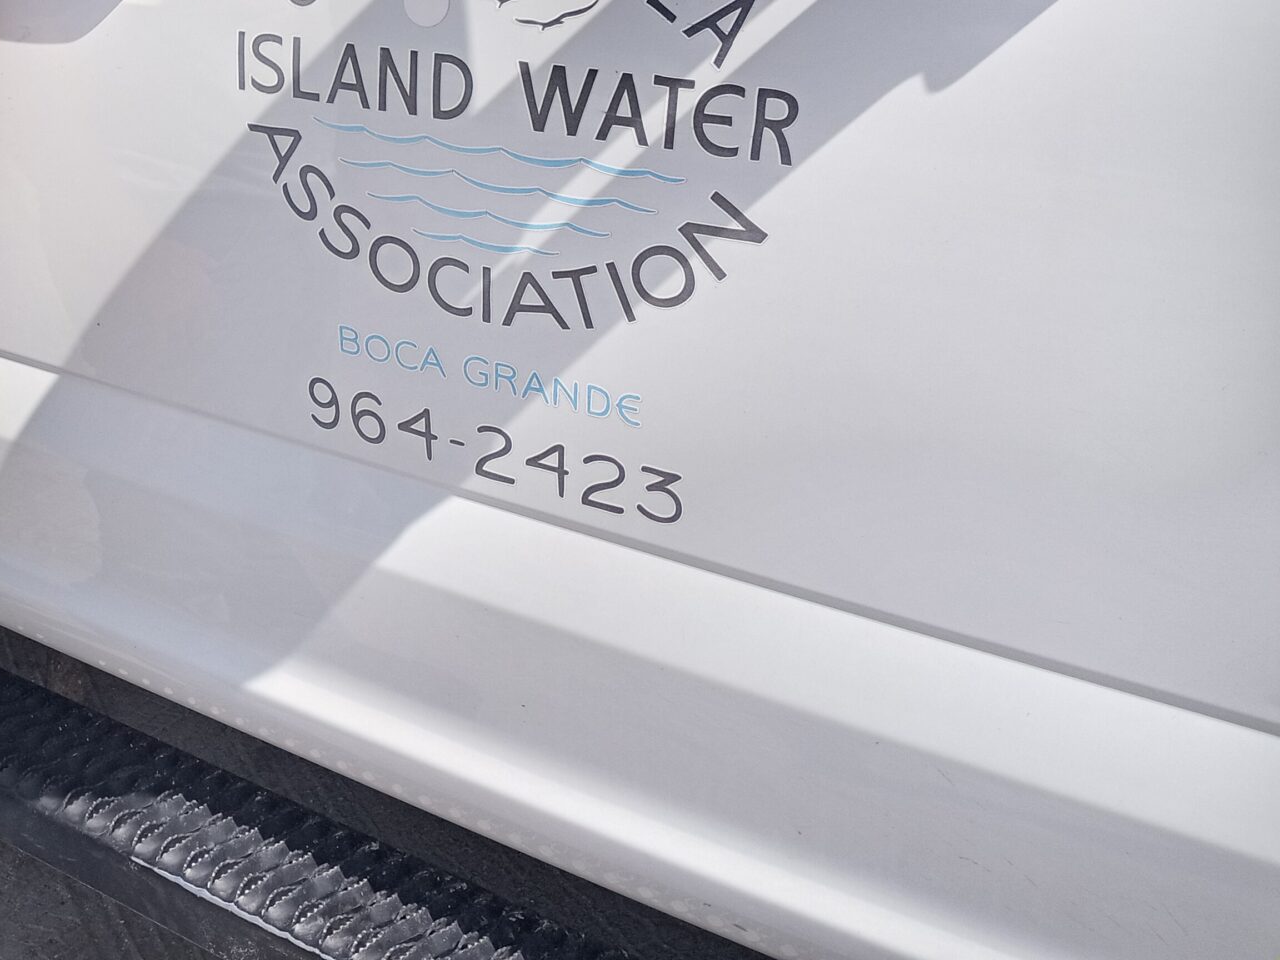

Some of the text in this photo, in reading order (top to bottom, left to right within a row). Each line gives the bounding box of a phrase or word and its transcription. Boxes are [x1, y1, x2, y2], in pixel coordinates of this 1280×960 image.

[237, 30, 799, 166] ISLAND WATER
[247, 120, 769, 330] ASSOCIATION
[338, 324, 643, 427] BOCA GRANDE
[308, 375, 683, 525] 964-2423
